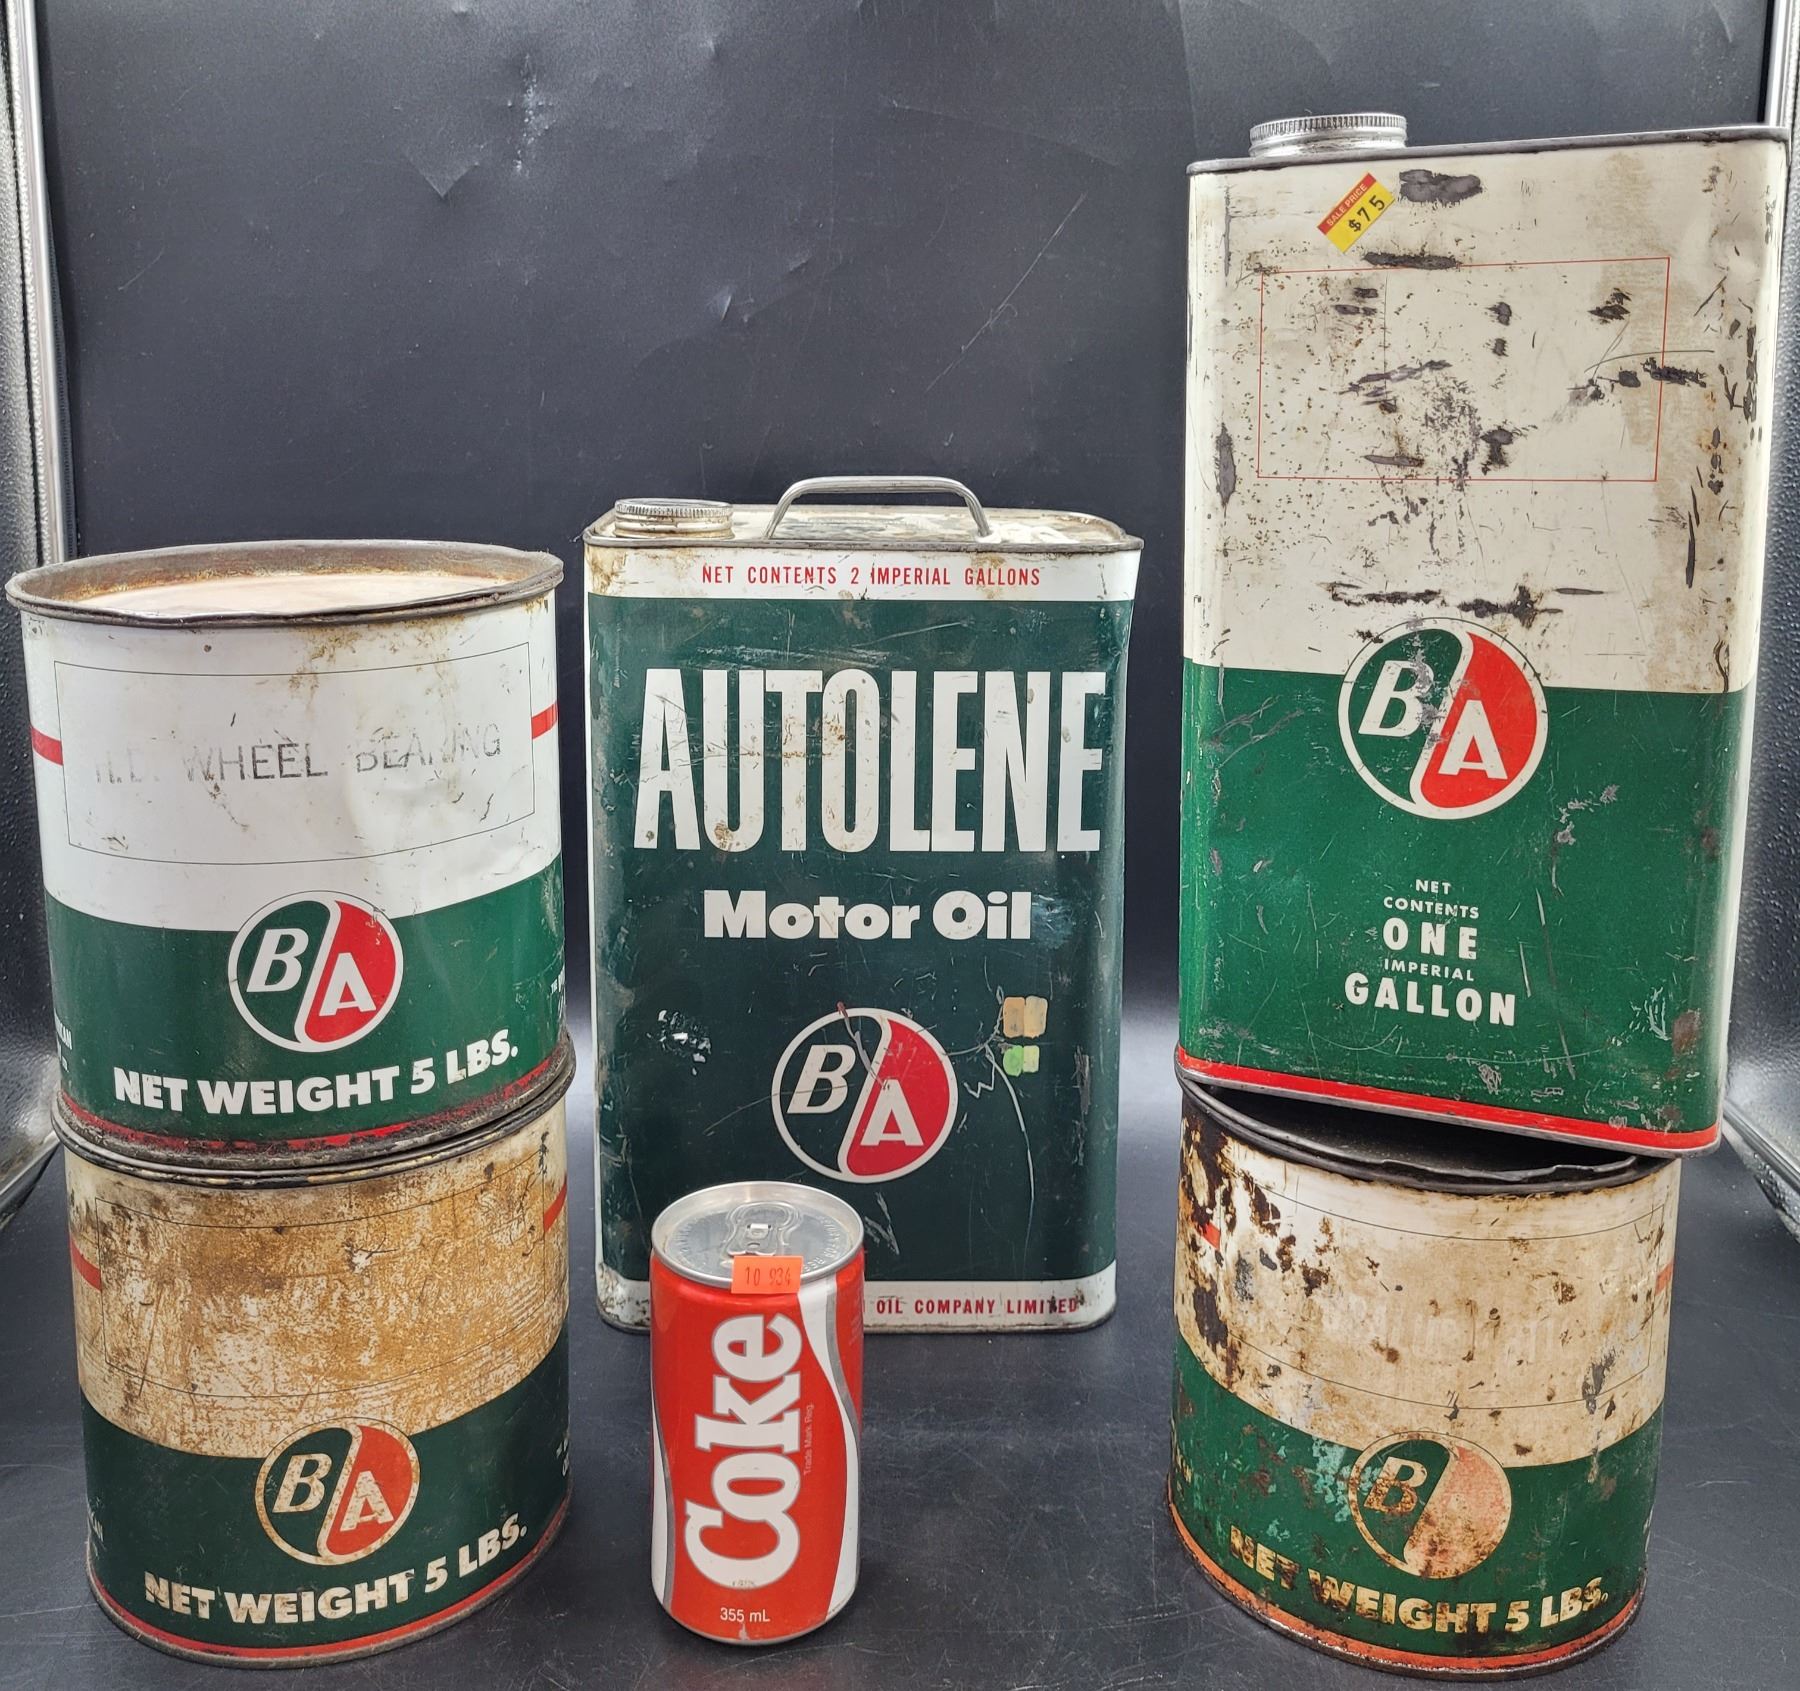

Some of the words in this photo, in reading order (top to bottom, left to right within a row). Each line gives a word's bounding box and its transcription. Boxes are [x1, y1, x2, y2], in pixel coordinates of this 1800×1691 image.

[1326, 207, 1346, 226] SALE
[1344, 183, 1368, 208] PRICE
[702, 565, 734, 585] NET
[747, 565, 837, 586] CONTENTS
[850, 566, 860, 586] 2
[870, 566, 951, 586] IMPERIAL
[964, 566, 1041, 587] GALLONS
[181, 742, 329, 783] WHEEL
[633, 667, 1107, 853] AUTOLENE
[1383, 896, 1480, 920] CONTENTS
[1415, 878, 1453, 896] NET
[703, 889, 921, 939] Motor
[932, 890, 1032, 939] Oil
[1382, 917, 1479, 962] ONE
[1383, 959, 1475, 982] IMPERIAL
[1343, 972, 1516, 1027] GALLON
[113, 1067, 189, 1113] NET
[196, 1065, 402, 1116] WEIGHT
[410, 1059, 437, 1095] 5
[444, 1029, 520, 1085] LBS.
[743, 1266, 761, 1287] 10
[876, 1298, 904, 1315] OIL
[914, 1298, 996, 1315] COMPANY
[683, 1312, 804, 1591] Coke
[144, 1571, 215, 1620] NET
[222, 1572, 415, 1625] WEIGHT
[423, 1557, 450, 1593] 5
[456, 1513, 529, 1577] LBS.
[1229, 1525, 1301, 1591] NET
[1307, 1567, 1497, 1634] WEIGHT
[1504, 1600, 1530, 1633] 5
[720, 1606, 745, 1623] 355
[749, 1608, 771, 1623] mL
